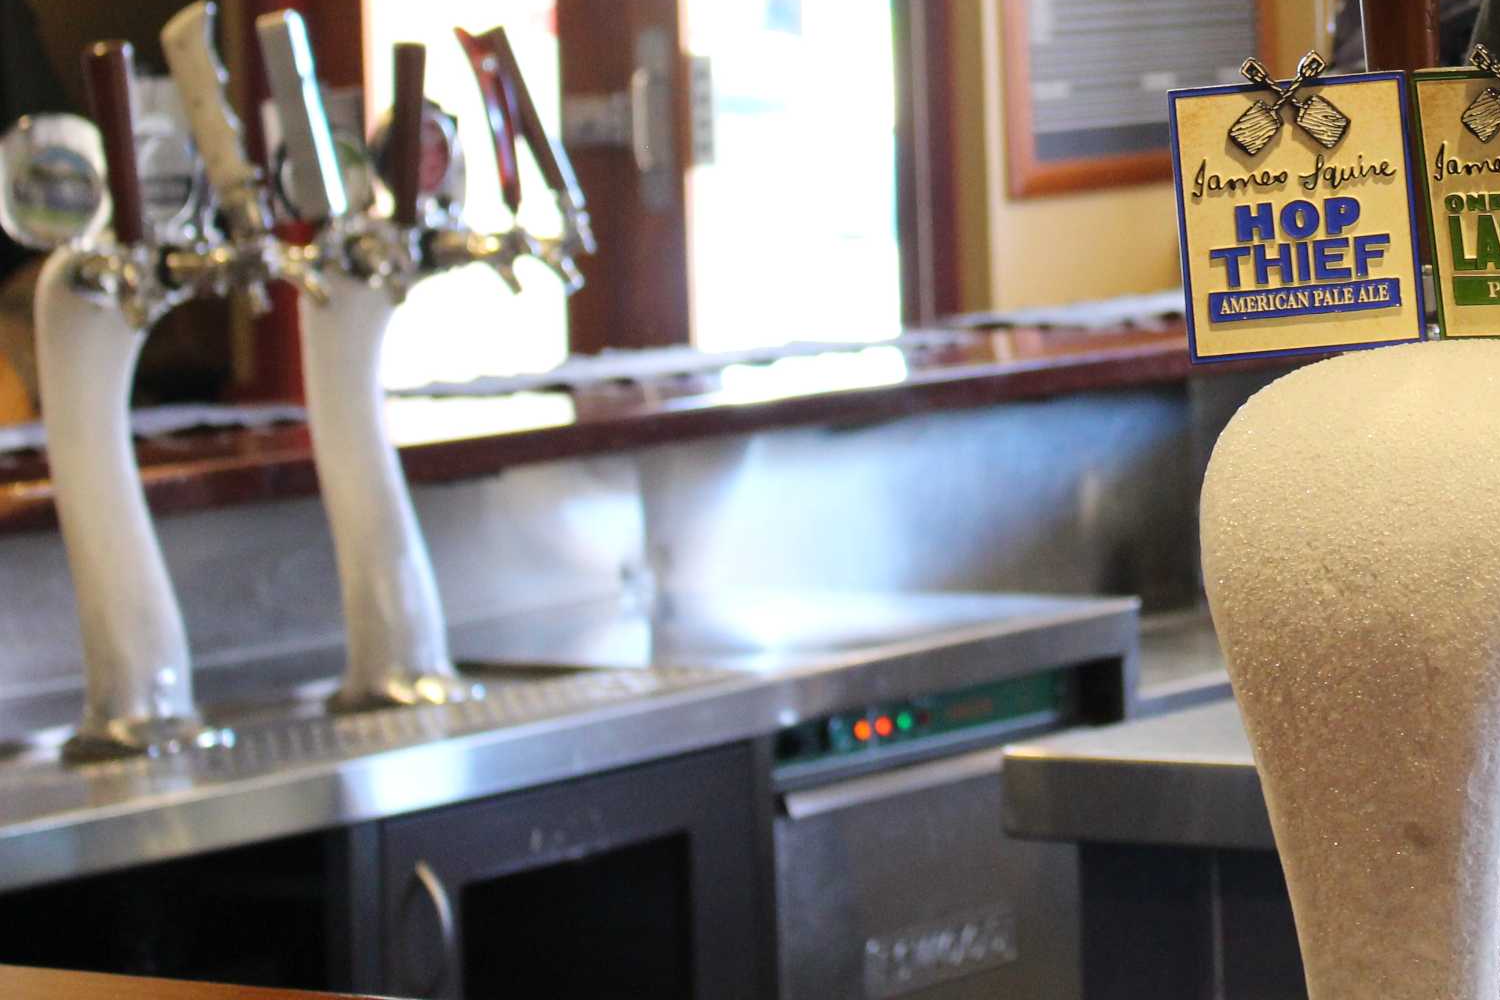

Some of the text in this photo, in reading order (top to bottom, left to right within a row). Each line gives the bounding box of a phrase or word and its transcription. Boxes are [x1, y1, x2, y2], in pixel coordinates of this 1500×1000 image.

[1192, 154, 1398, 199] James Squire
[1235, 197, 1360, 243] HOP
[1210, 233, 1390, 288] THIEF
[1220, 284, 1390, 316] AMERICAN PALE ALE
